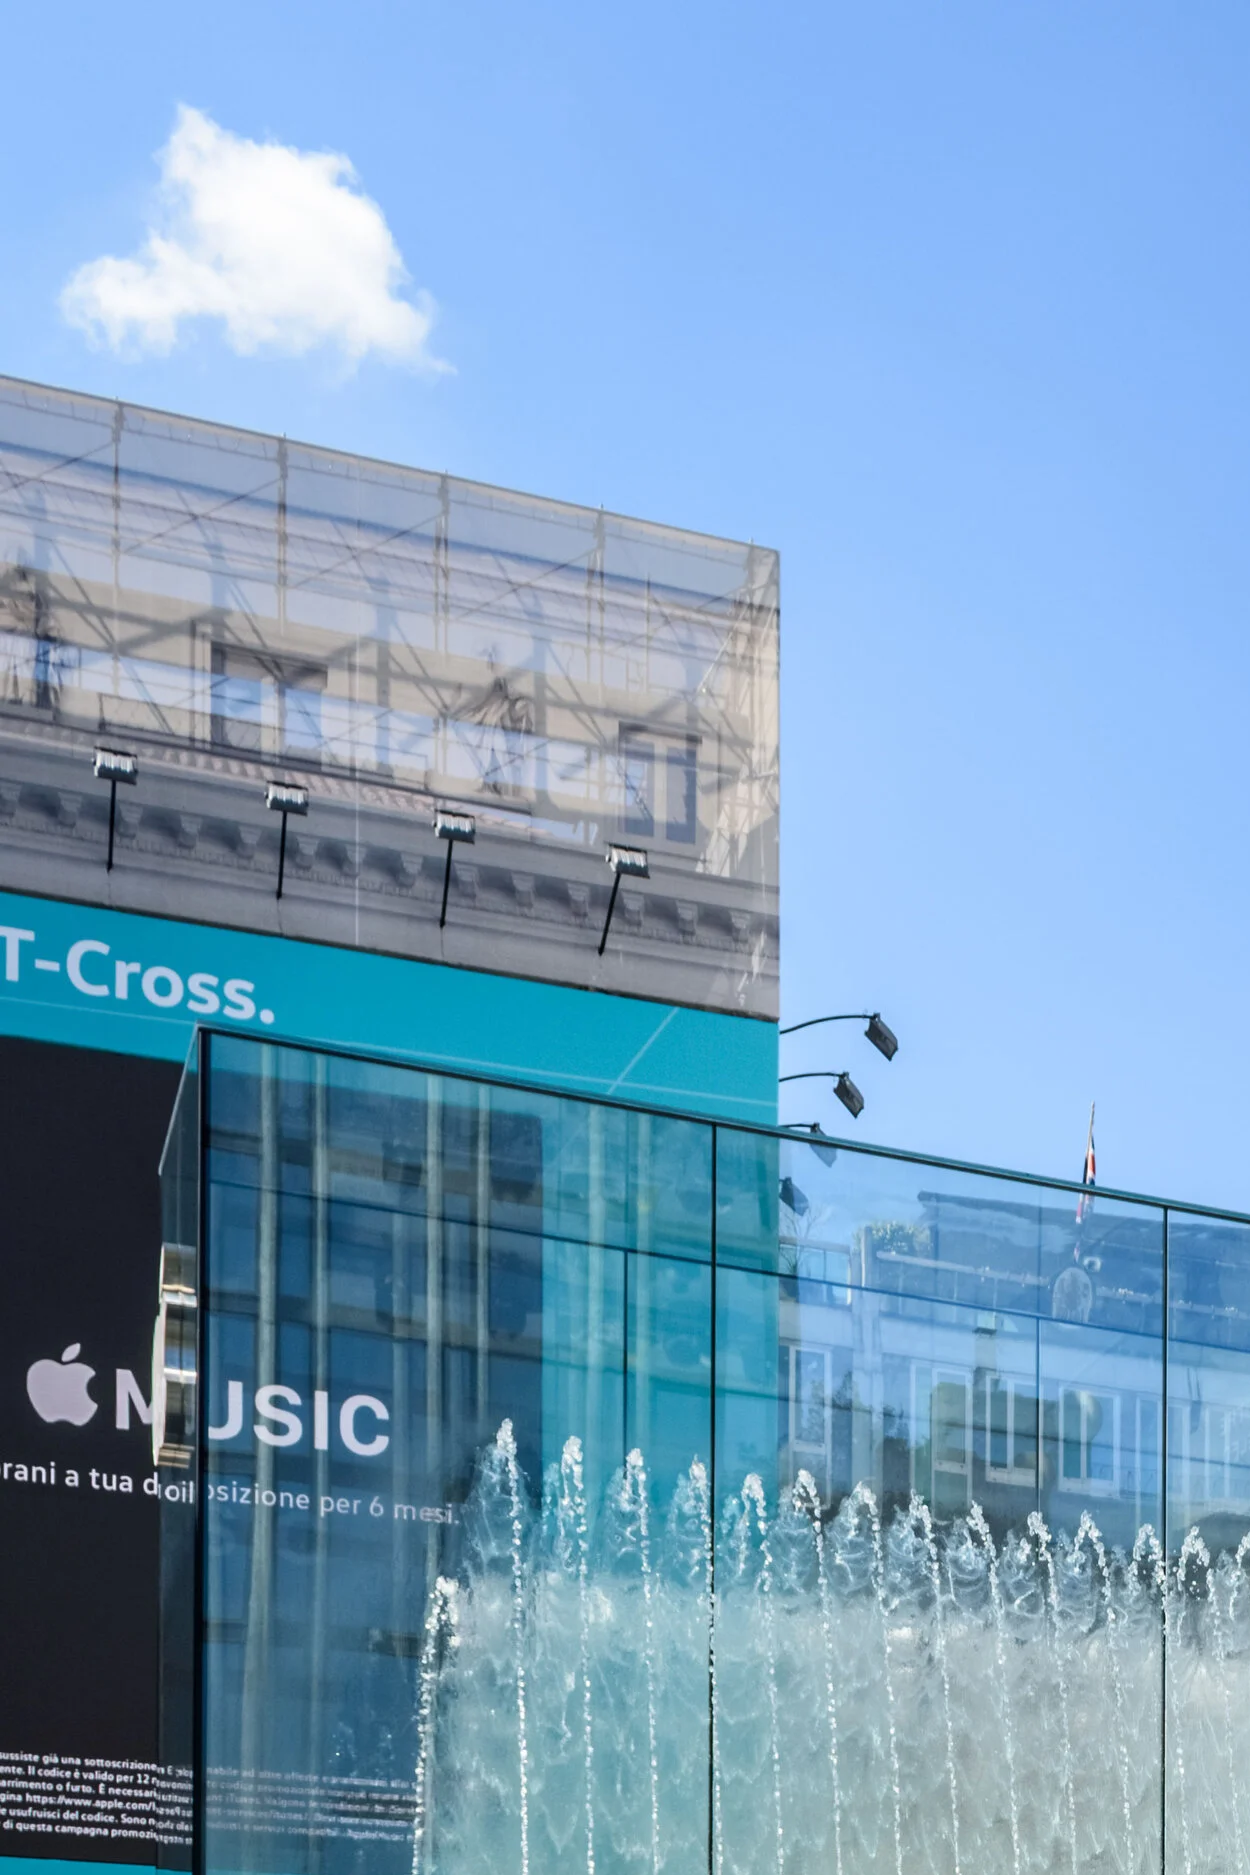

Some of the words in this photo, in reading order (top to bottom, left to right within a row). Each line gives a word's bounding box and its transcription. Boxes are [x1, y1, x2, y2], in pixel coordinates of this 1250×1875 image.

[0, 925, 275, 1025] T-Cross.
[0, 1461, 56, 1485] rani
[64, 1469, 80, 1488] a
[89, 1468, 134, 1493] tua
[320, 1495, 361, 1518] per
[369, 1496, 384, 1517] 6
[61, 1757, 81, 1765] una
[37, 1767, 72, 1778] codice
[82, 1770, 114, 1782] valido
[116, 1774, 134, 1784] per
[136, 1773, 150, 1785] 12
[108, 1787, 157, 1798] necessari
[62, 1809, 79, 1820] del
[121, 1813, 147, 1825] Sono
[15, 1822, 53, 1832] questa
[55, 1825, 109, 1837] campagna
[111, 1828, 157, 1839] promozi
